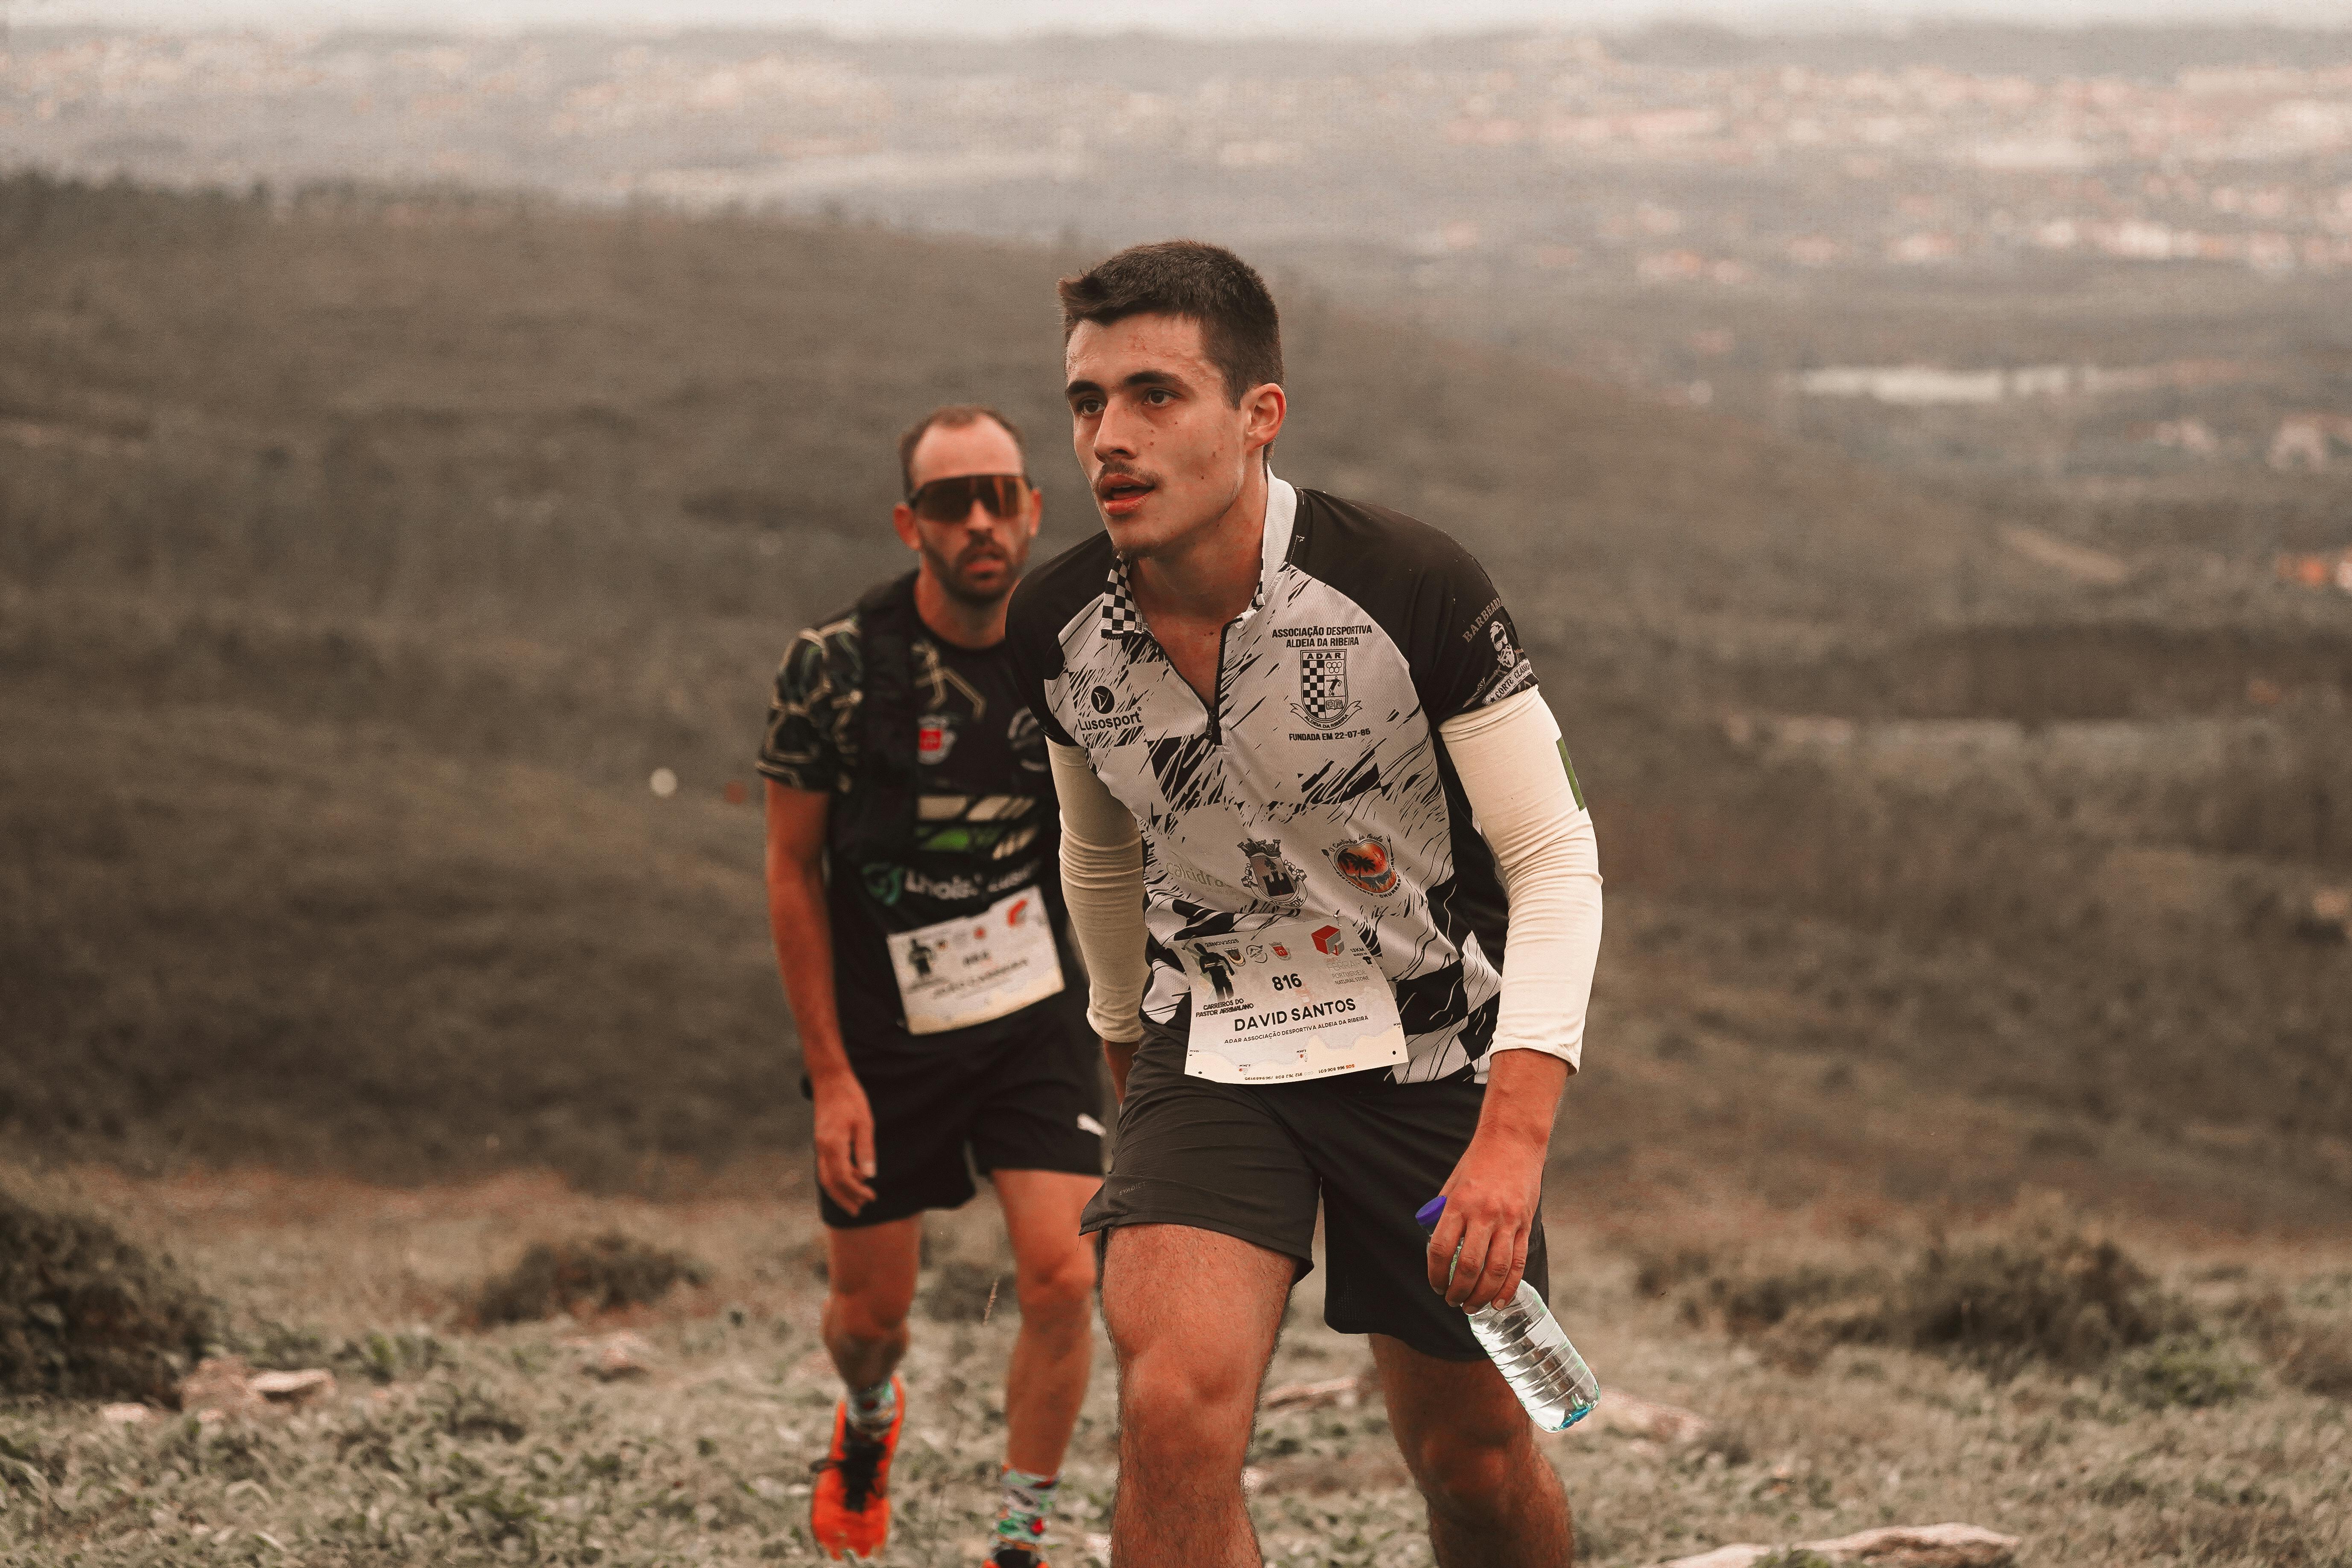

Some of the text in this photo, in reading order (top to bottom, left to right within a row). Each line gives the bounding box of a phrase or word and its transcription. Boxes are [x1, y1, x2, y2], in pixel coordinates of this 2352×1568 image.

[1272, 625, 1372, 638] ASSOCIAÇÃO DESPORTIVA
[1286, 637, 1359, 648] ALDEIA DA RIBEIRA
[1078, 711, 1141, 731] Lusosport
[1304, 716, 1322, 728] ALDEIA
[1330, 714, 1349, 728] RIBEIRA
[1332, 969, 1366, 978] PORTUGUESE
[1272, 973, 1302, 992] 816
[1235, 998, 1356, 1032] DAVID SANTOS
[1243, 1031, 1281, 1042] ASSOCIAÇÃO
[1282, 1025, 1317, 1036] DESPORTIVA
